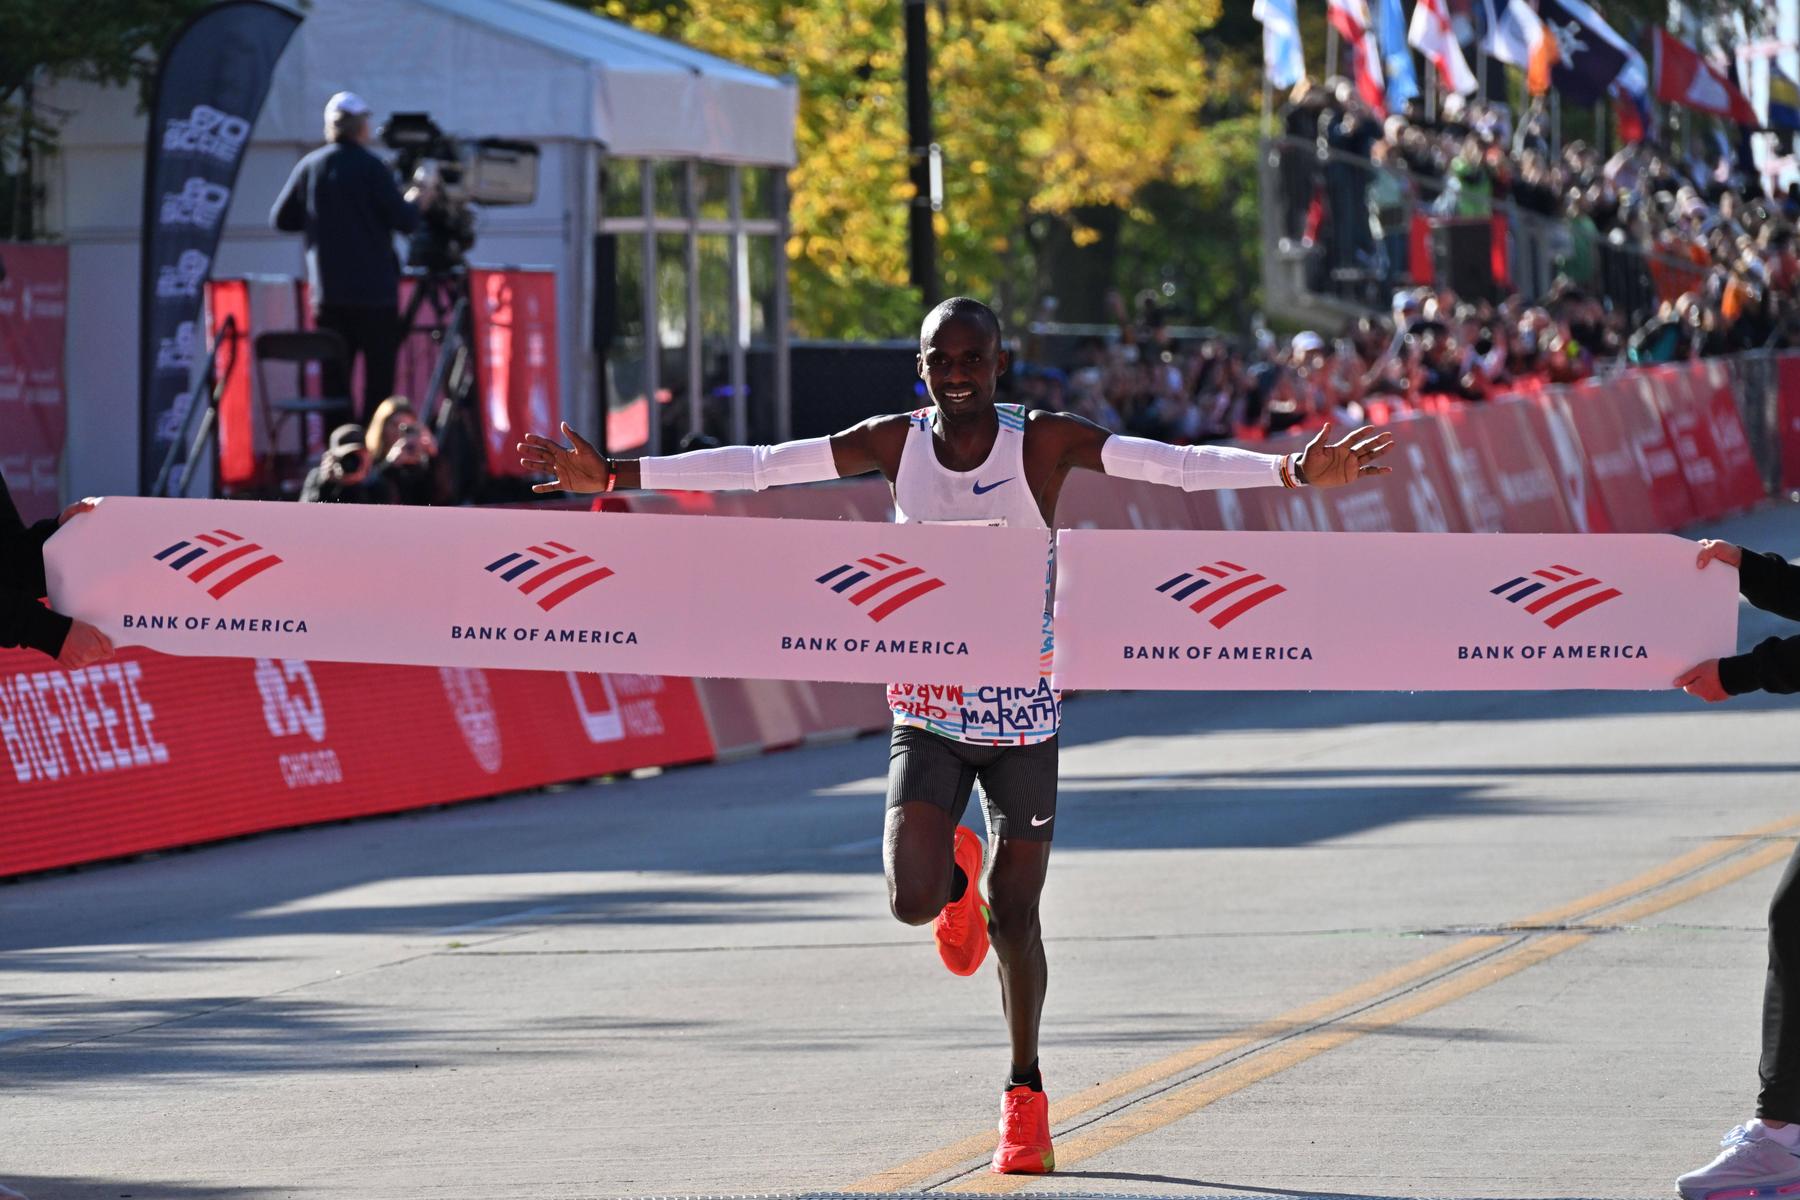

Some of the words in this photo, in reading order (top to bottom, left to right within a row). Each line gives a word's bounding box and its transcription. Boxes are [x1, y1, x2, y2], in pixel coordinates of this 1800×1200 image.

[123, 614, 178, 630] BANK
[184, 616, 211, 630] OF
[214, 618, 308, 633] AMERICA
[451, 625, 507, 641] BANK
[513, 627, 540, 641] OF
[544, 629, 638, 645] AMERICA
[781, 636, 837, 652] BANK
[843, 638, 870, 652] OF
[874, 639, 969, 656] AMERICA
[1123, 645, 1180, 660] BANK
[1186, 646, 1213, 660] OF
[1217, 646, 1313, 661] AMERICA
[1458, 646, 1514, 660] BANK
[1521, 645, 1547, 659] OF
[1552, 645, 1648, 659] AMERICA
